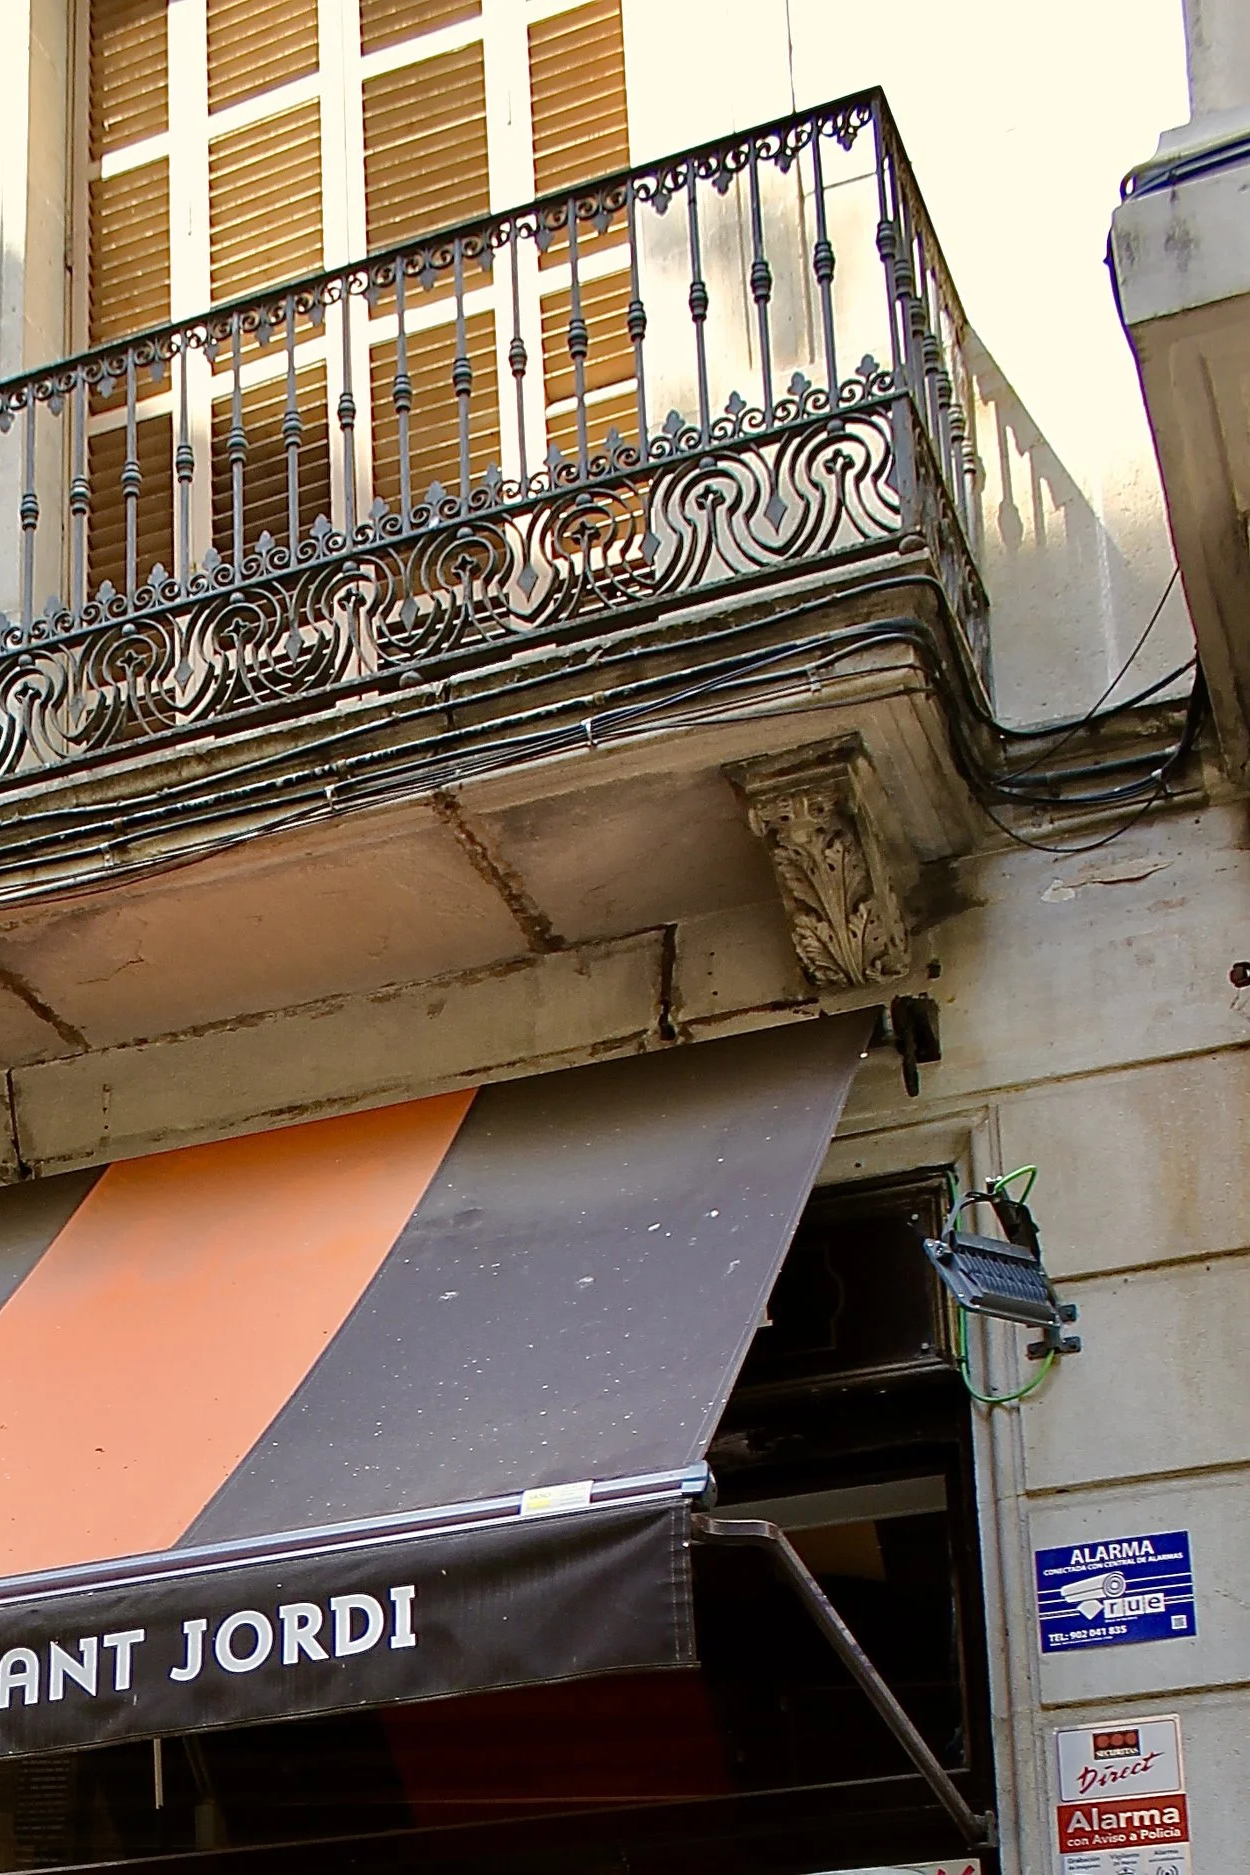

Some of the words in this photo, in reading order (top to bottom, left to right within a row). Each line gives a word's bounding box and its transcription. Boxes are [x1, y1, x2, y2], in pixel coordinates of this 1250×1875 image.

[1043, 1565, 1086, 1576] CONECTADA
[1104, 1558, 1136, 1569] CENTRAL
[1148, 1552, 1184, 1563] ALARMAS
[1070, 1540, 1155, 1565] ALARMA
[170, 1585, 417, 1682] JORDI
[1067, 1806, 1181, 1833] Alarma
[1067, 1838, 1090, 1847] con
[1092, 1833, 1127, 1845] Aviso
[1129, 1832, 1138, 1841] a
